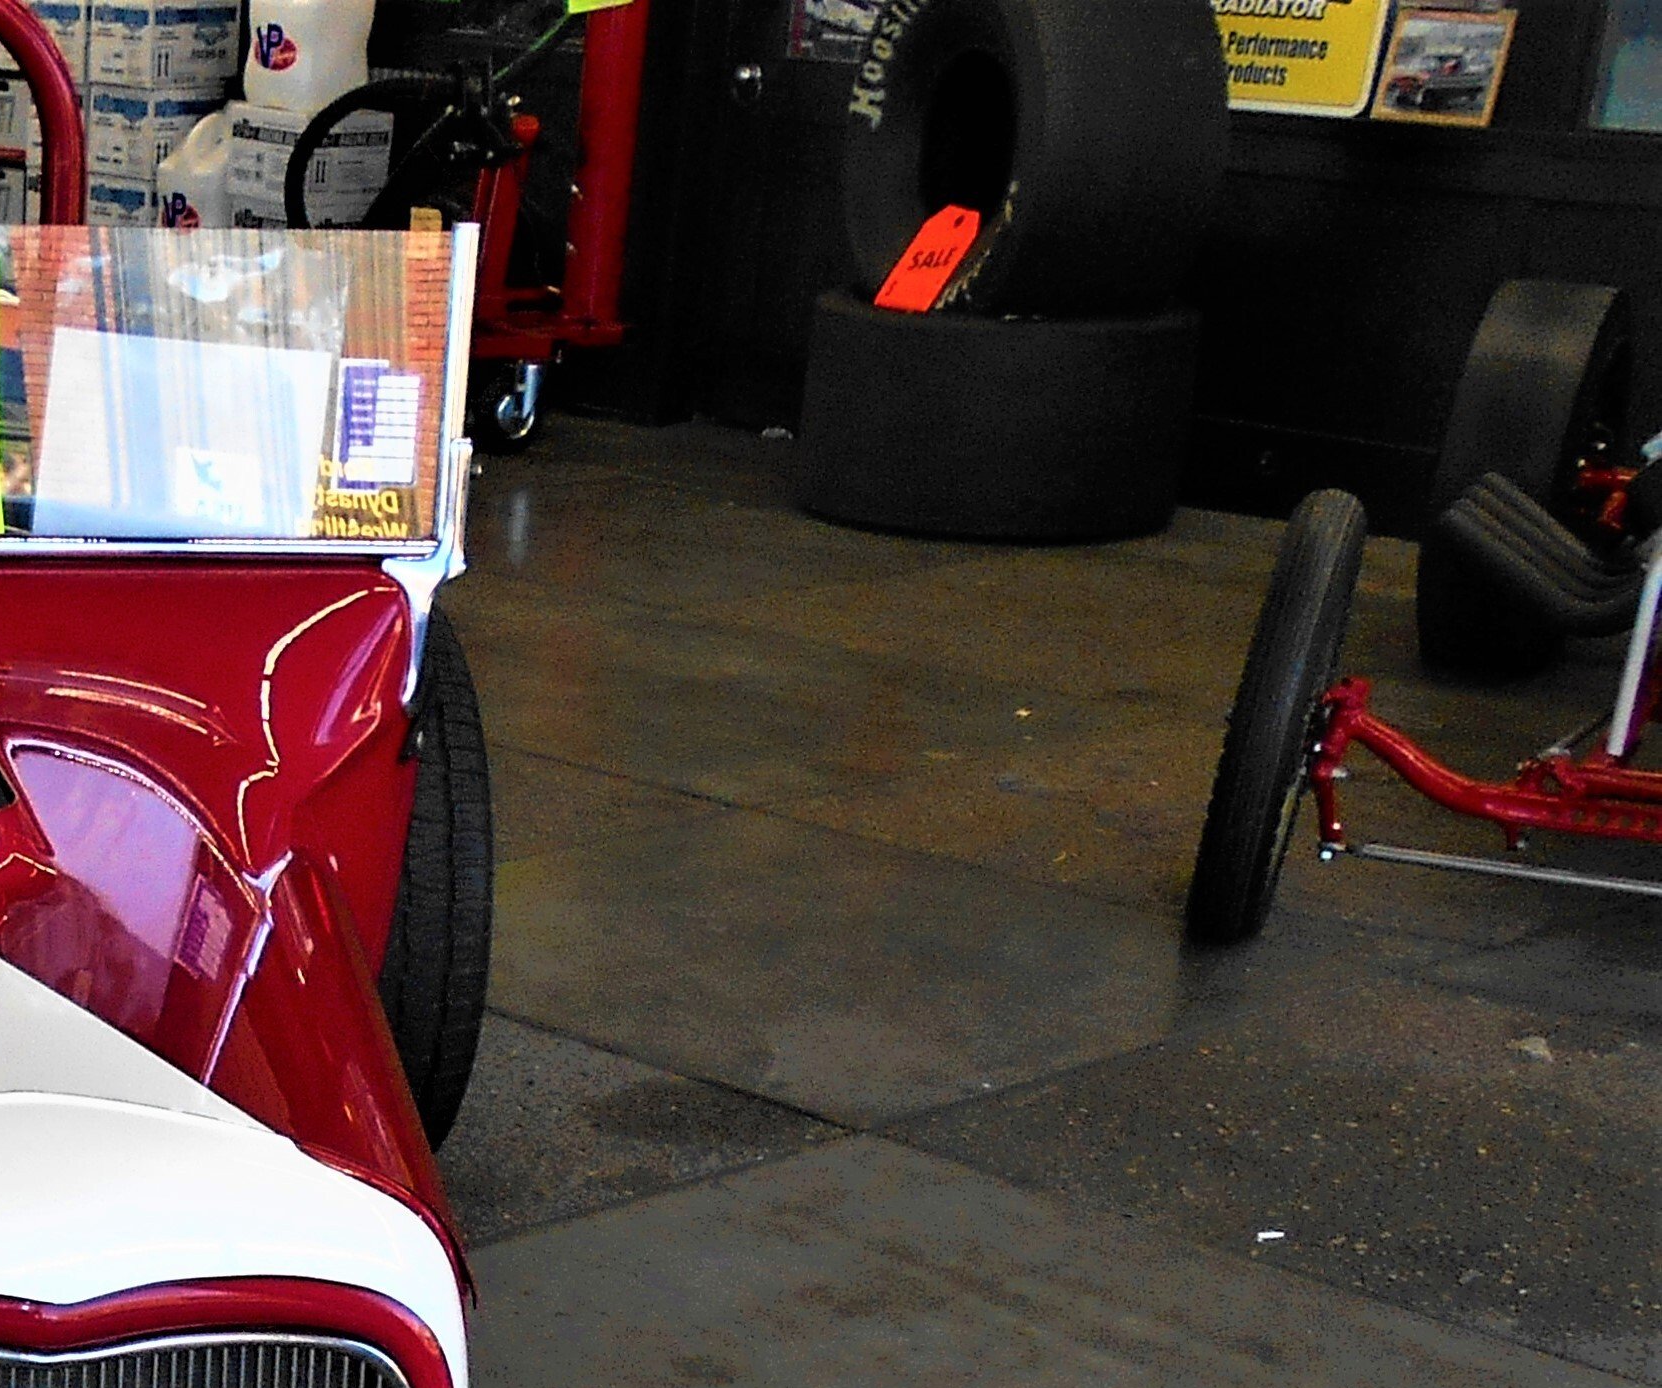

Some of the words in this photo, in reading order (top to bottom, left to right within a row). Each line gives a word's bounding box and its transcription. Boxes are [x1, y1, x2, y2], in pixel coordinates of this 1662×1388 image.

[1210, 0, 1328, 20] ADIATOR
[256, 23, 284, 69] VP
[1226, 31, 1328, 60] Performance
[1225, 61, 1288, 86] roducts
[907, 246, 959, 271] SALE
